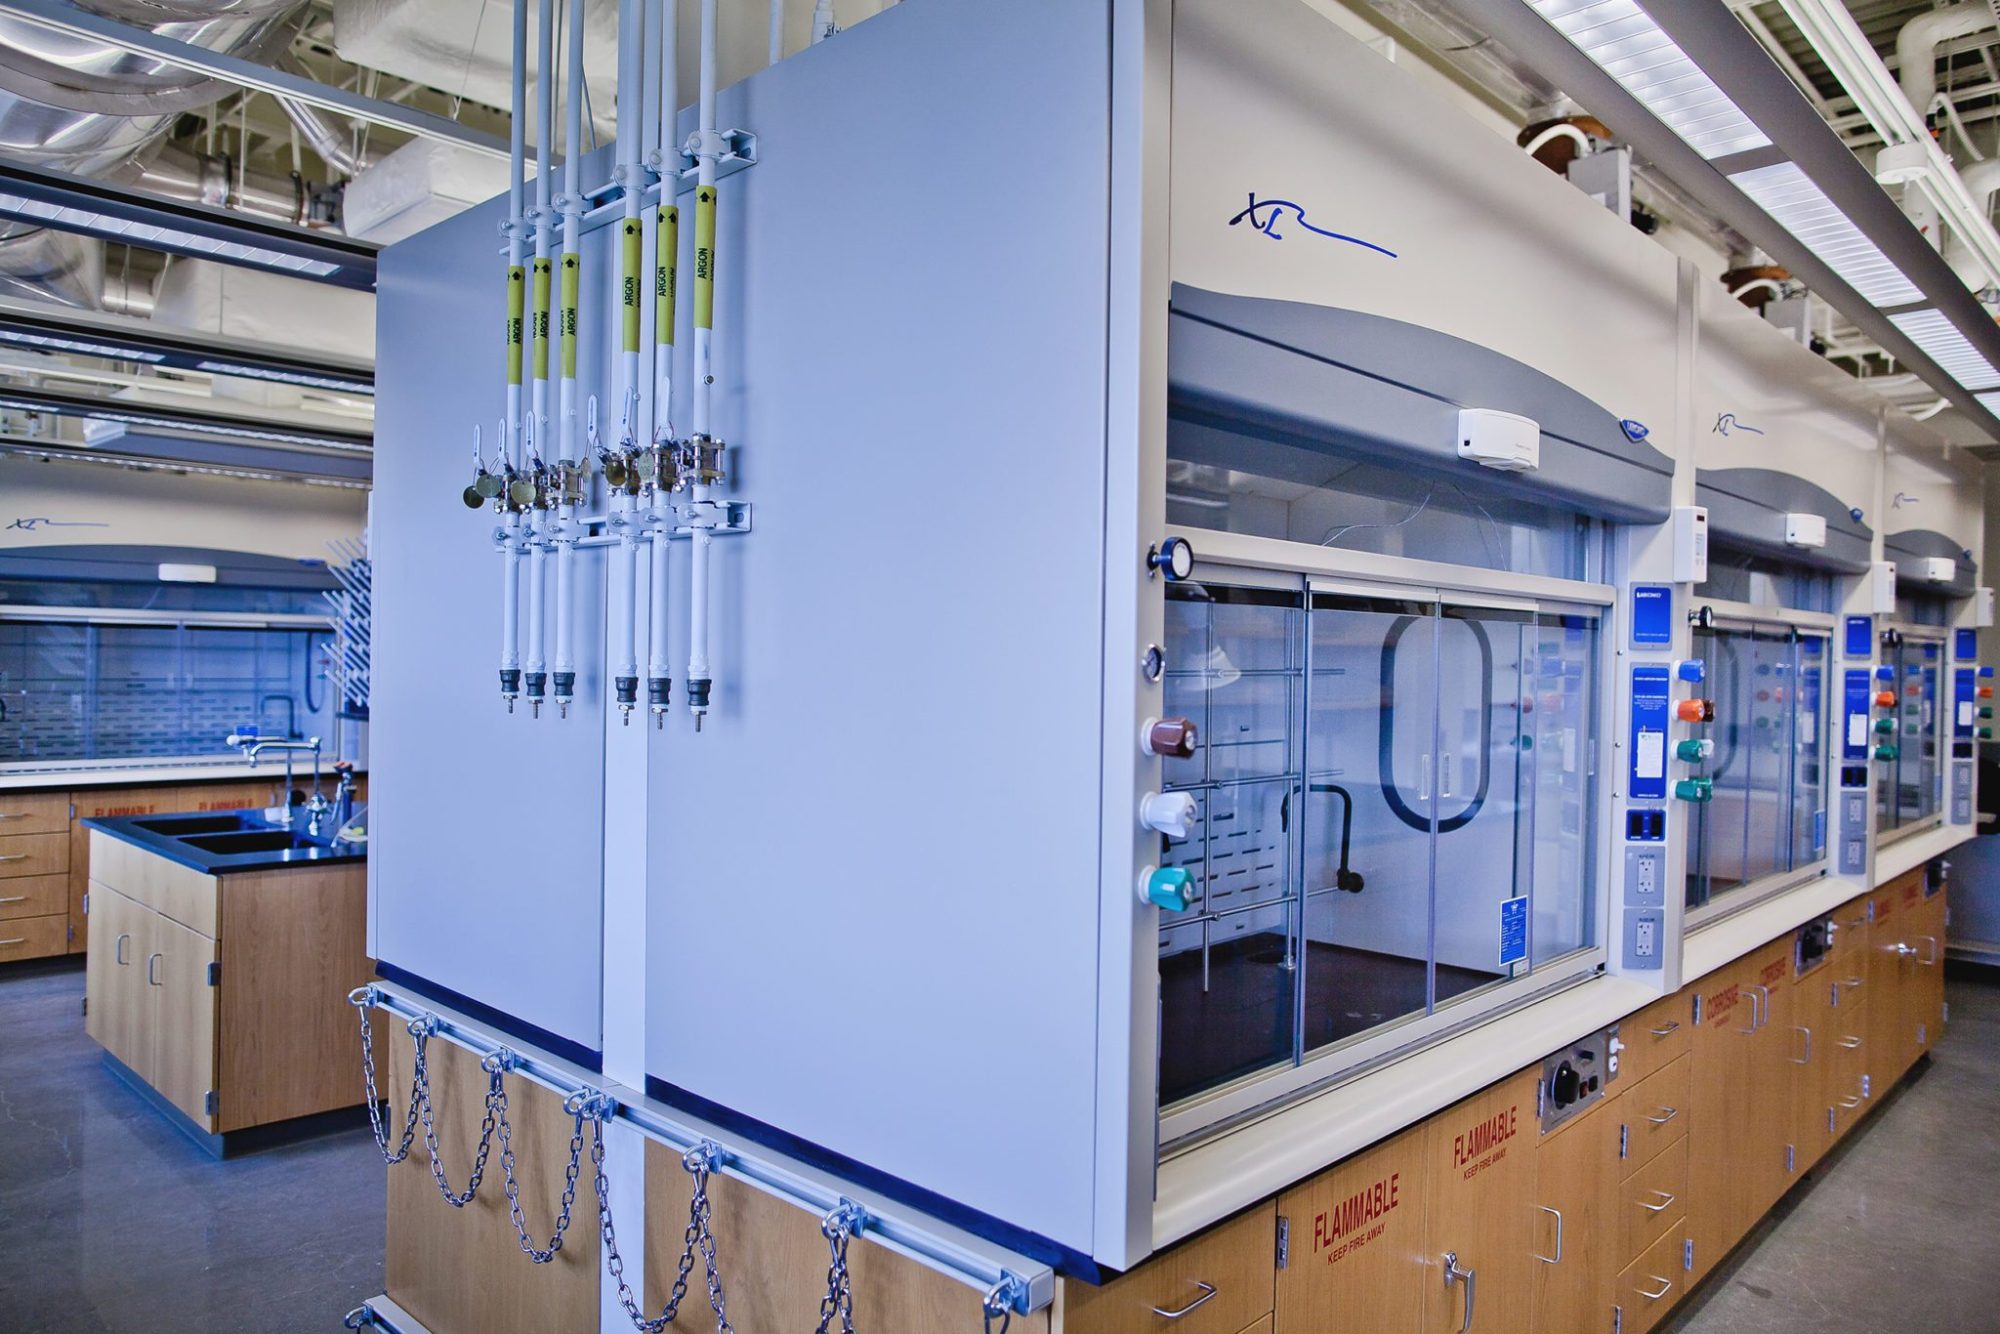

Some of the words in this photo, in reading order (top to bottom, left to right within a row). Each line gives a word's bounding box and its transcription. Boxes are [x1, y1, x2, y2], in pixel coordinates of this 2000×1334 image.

[697, 248, 708, 280] ARGON
[624, 276, 634, 307] ARGON
[657, 266, 666, 297] ARGON
[512, 317, 521, 345] ARGON
[540, 310, 549, 339] ARGON
[567, 307, 576, 337] ARGON
[1453, 1105, 1518, 1169] FLAMMABLE
[1463, 1163, 1478, 1181] KEEP
[1492, 1147, 1507, 1164] AWAY
[1313, 1173, 1399, 1253] FLAMMABLE
[1327, 1244, 1347, 1266] KEEP
[1348, 1233, 1365, 1253] FIRE
[1366, 1222, 1386, 1243] AWAY
